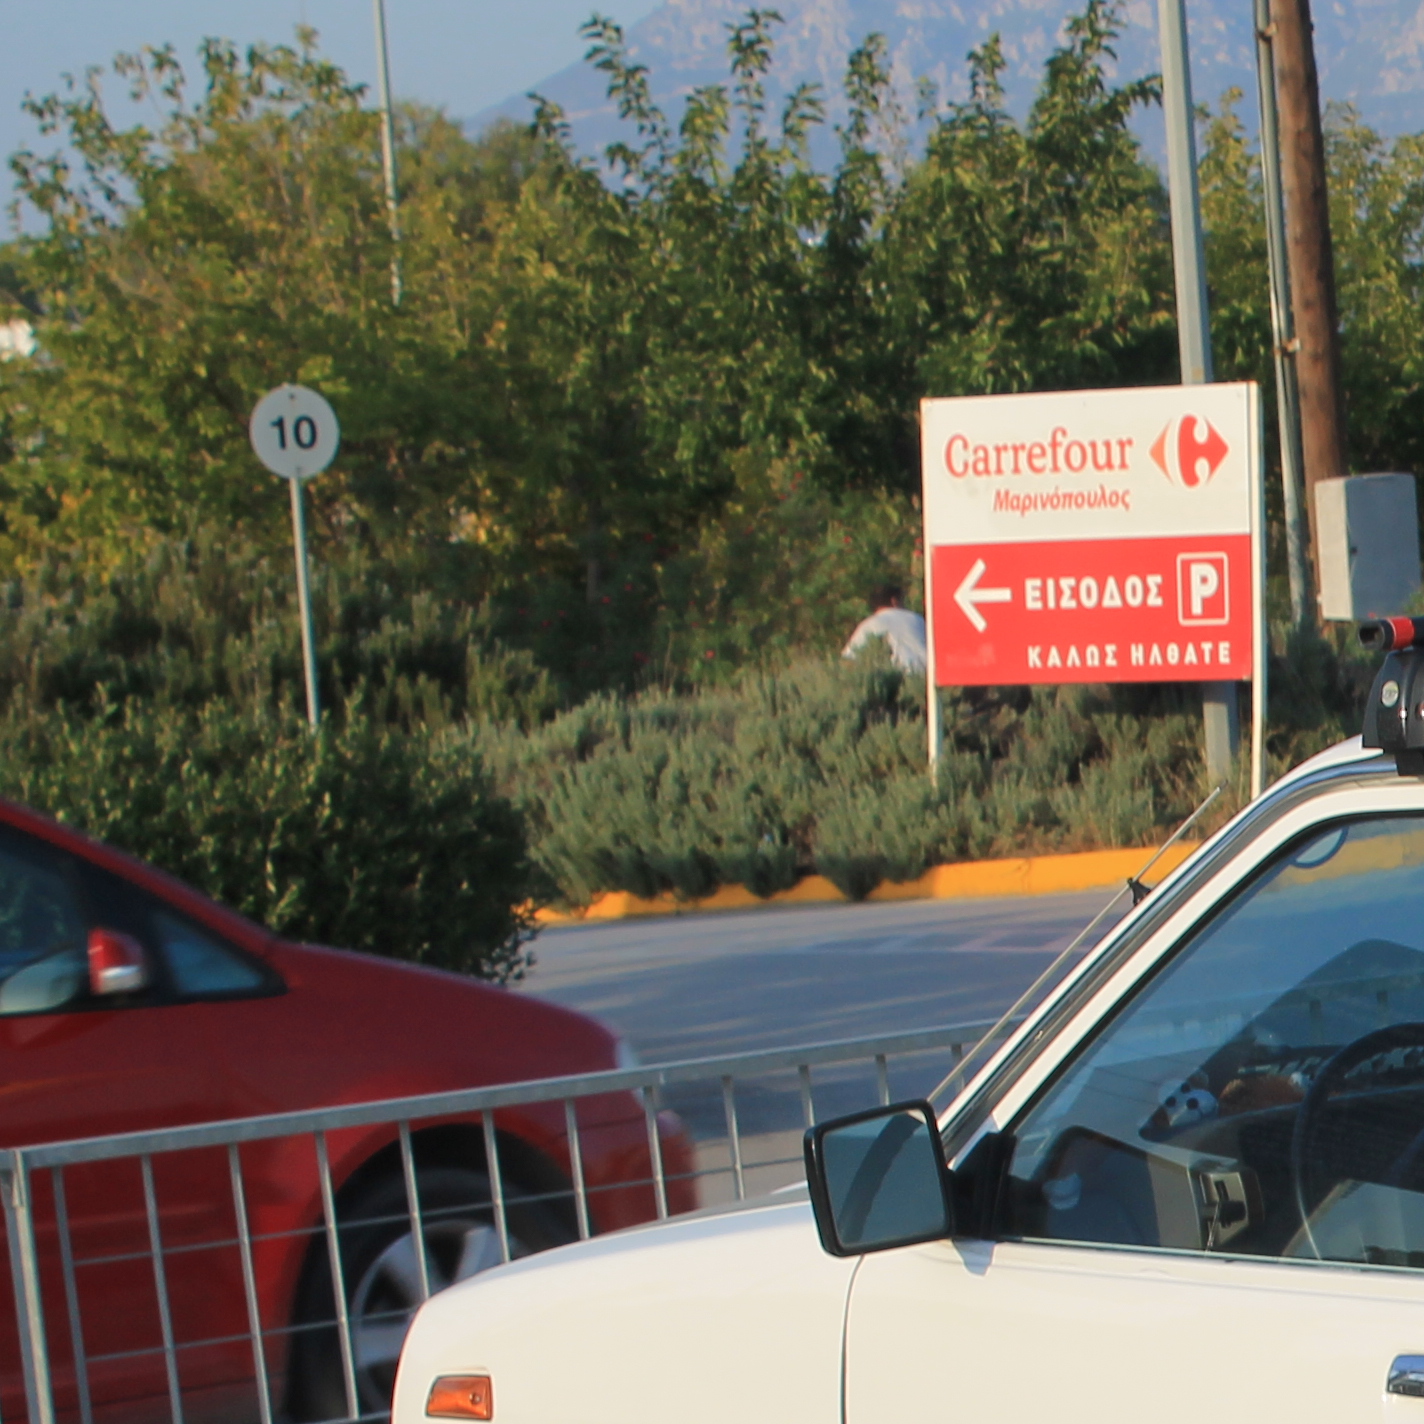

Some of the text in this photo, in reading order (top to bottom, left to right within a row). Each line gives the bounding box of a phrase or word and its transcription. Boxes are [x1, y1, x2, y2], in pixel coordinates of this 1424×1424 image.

[270, 415, 317, 450] 10
[944, 427, 1133, 478] Carrefour
[993, 484, 1131, 517] Μαρινόπουλος
[1024, 562, 1219, 616] ΕΙΣΟΔΟΣ P
[1027, 641, 1231, 669] ΚΑΛΩΣ ΗΛΘΑΤΕ
